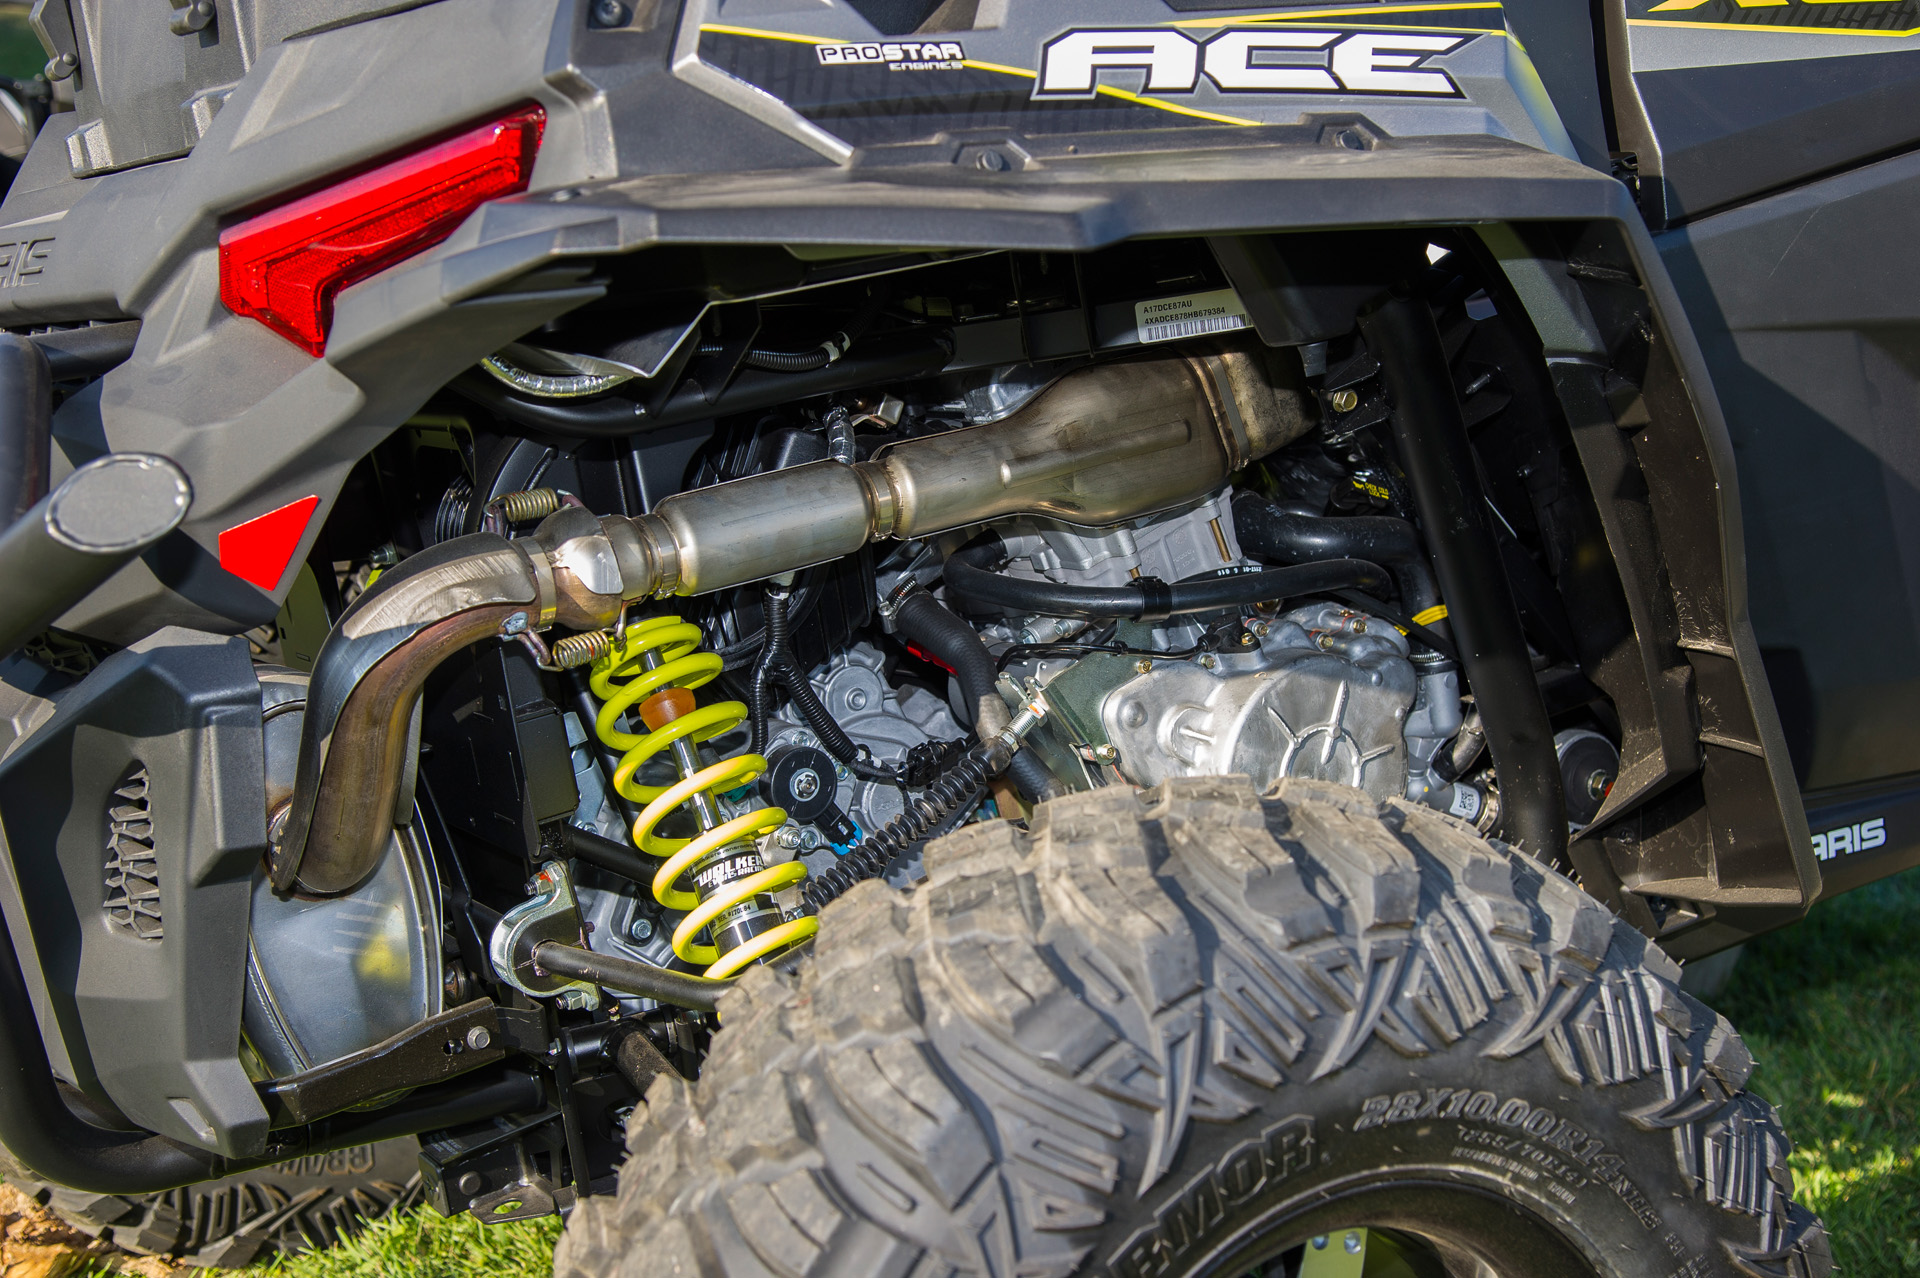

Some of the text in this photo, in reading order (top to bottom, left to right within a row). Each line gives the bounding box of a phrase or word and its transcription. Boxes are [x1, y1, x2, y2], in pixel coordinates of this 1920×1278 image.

[816, 42, 964, 65] PROSTAR
[1040, 28, 1472, 96] ACE
[889, 60, 964, 72] ENGINES
[1143, 300, 1193, 314] A17DCE87AU
[1144, 306, 1226, 325] 4XADCE878HB679384
[1811, 817, 1886, 862] ARIS
[699, 855, 764, 887] WALKER
